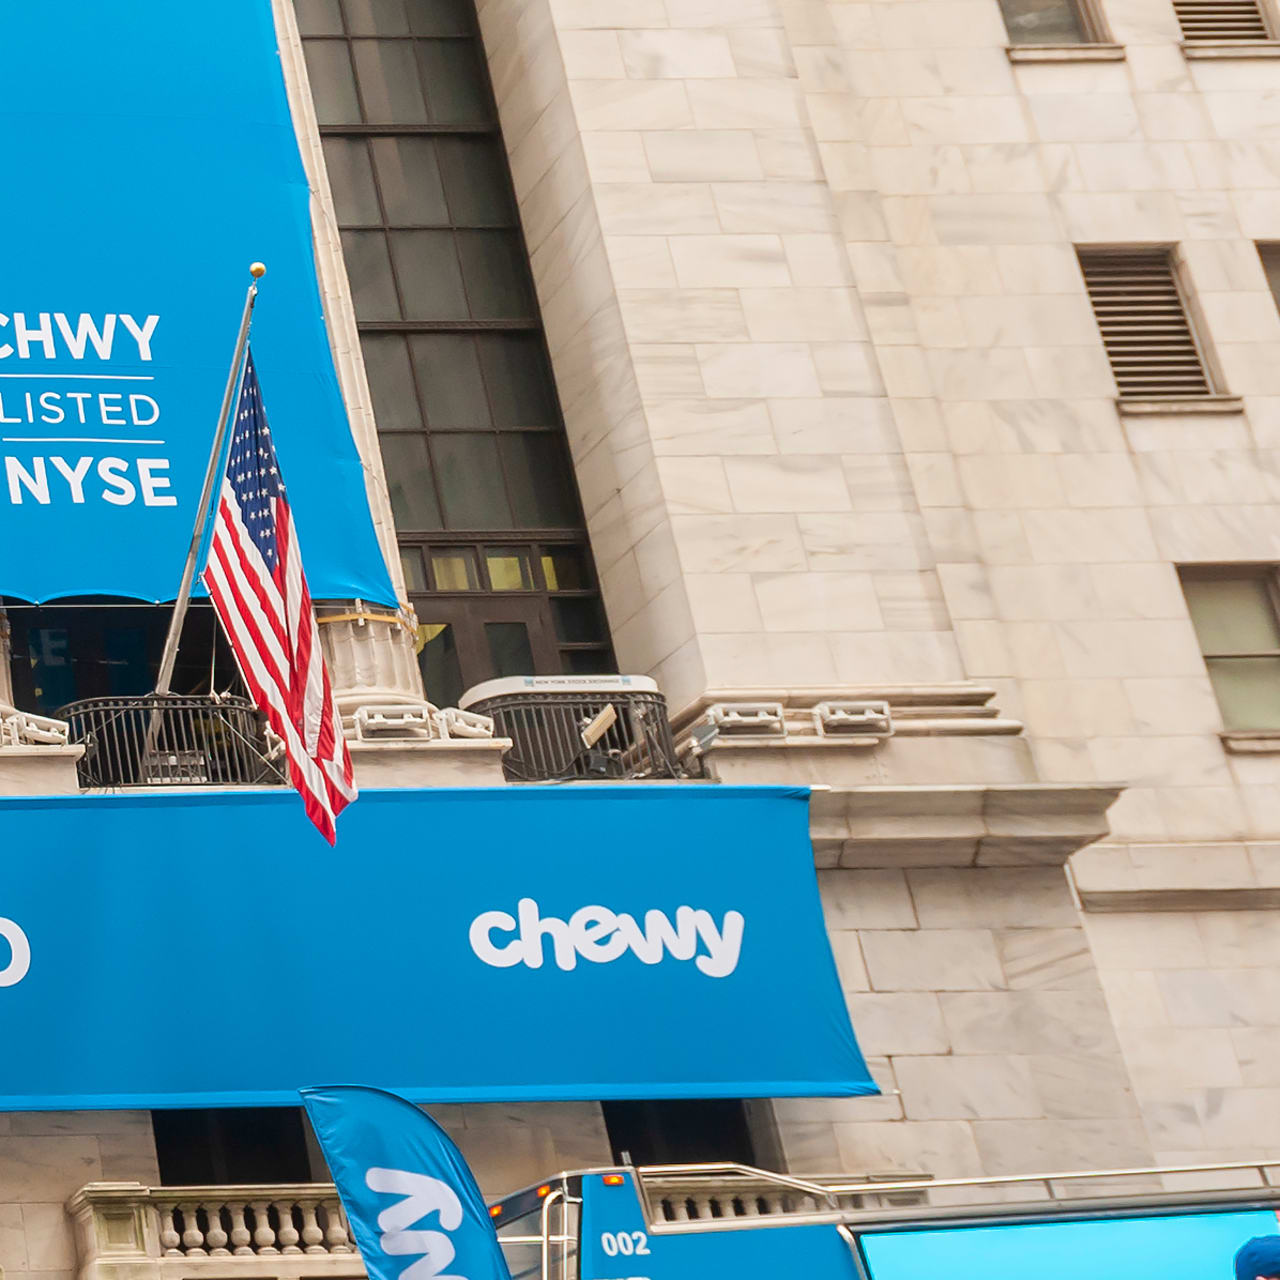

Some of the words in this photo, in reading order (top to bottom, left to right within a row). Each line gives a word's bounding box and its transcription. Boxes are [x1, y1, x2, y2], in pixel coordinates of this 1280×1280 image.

[4, 456, 178, 506] NYSE
[468, 897, 745, 978] chewy
[601, 1231, 652, 1257] 002
